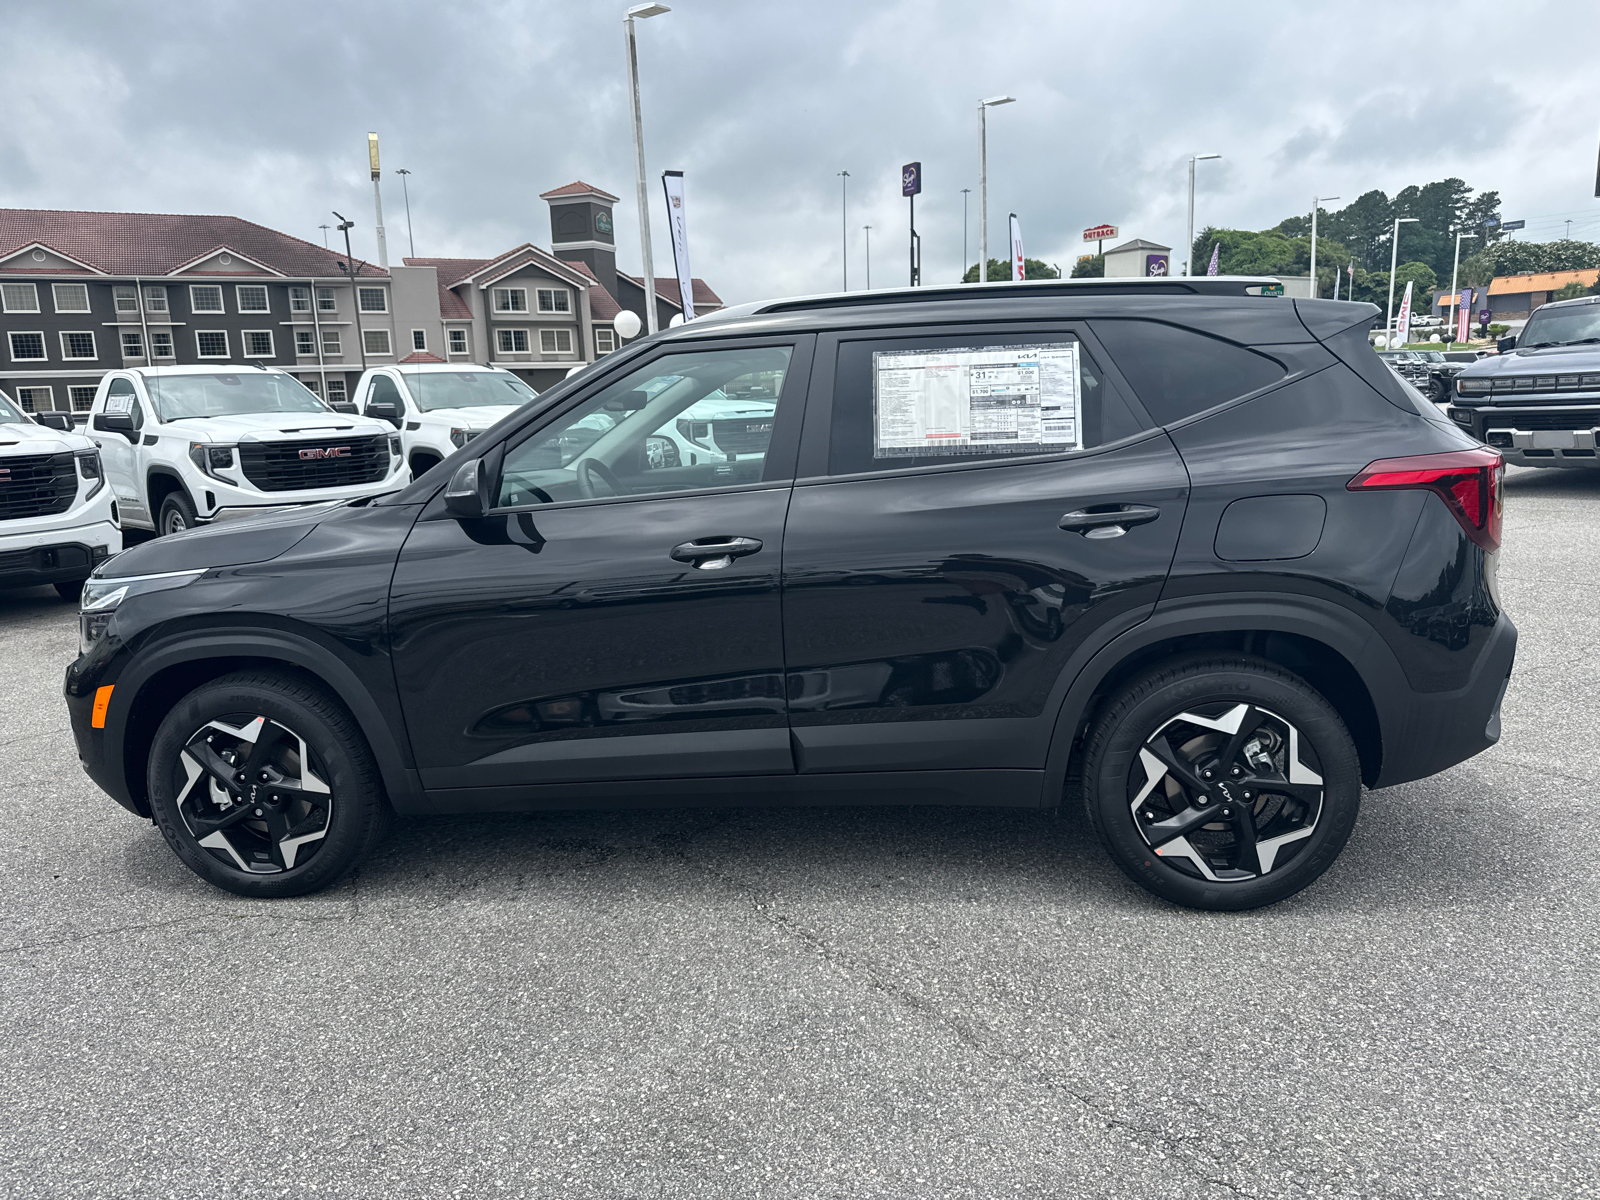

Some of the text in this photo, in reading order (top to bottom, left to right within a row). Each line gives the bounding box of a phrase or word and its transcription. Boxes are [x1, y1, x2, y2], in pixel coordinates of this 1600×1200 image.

[1083, 228, 1115, 240] OUTBACK
[1398, 293, 1410, 333] GMC
[975, 371, 986, 379] 31
[299, 446, 352, 460] GMC
